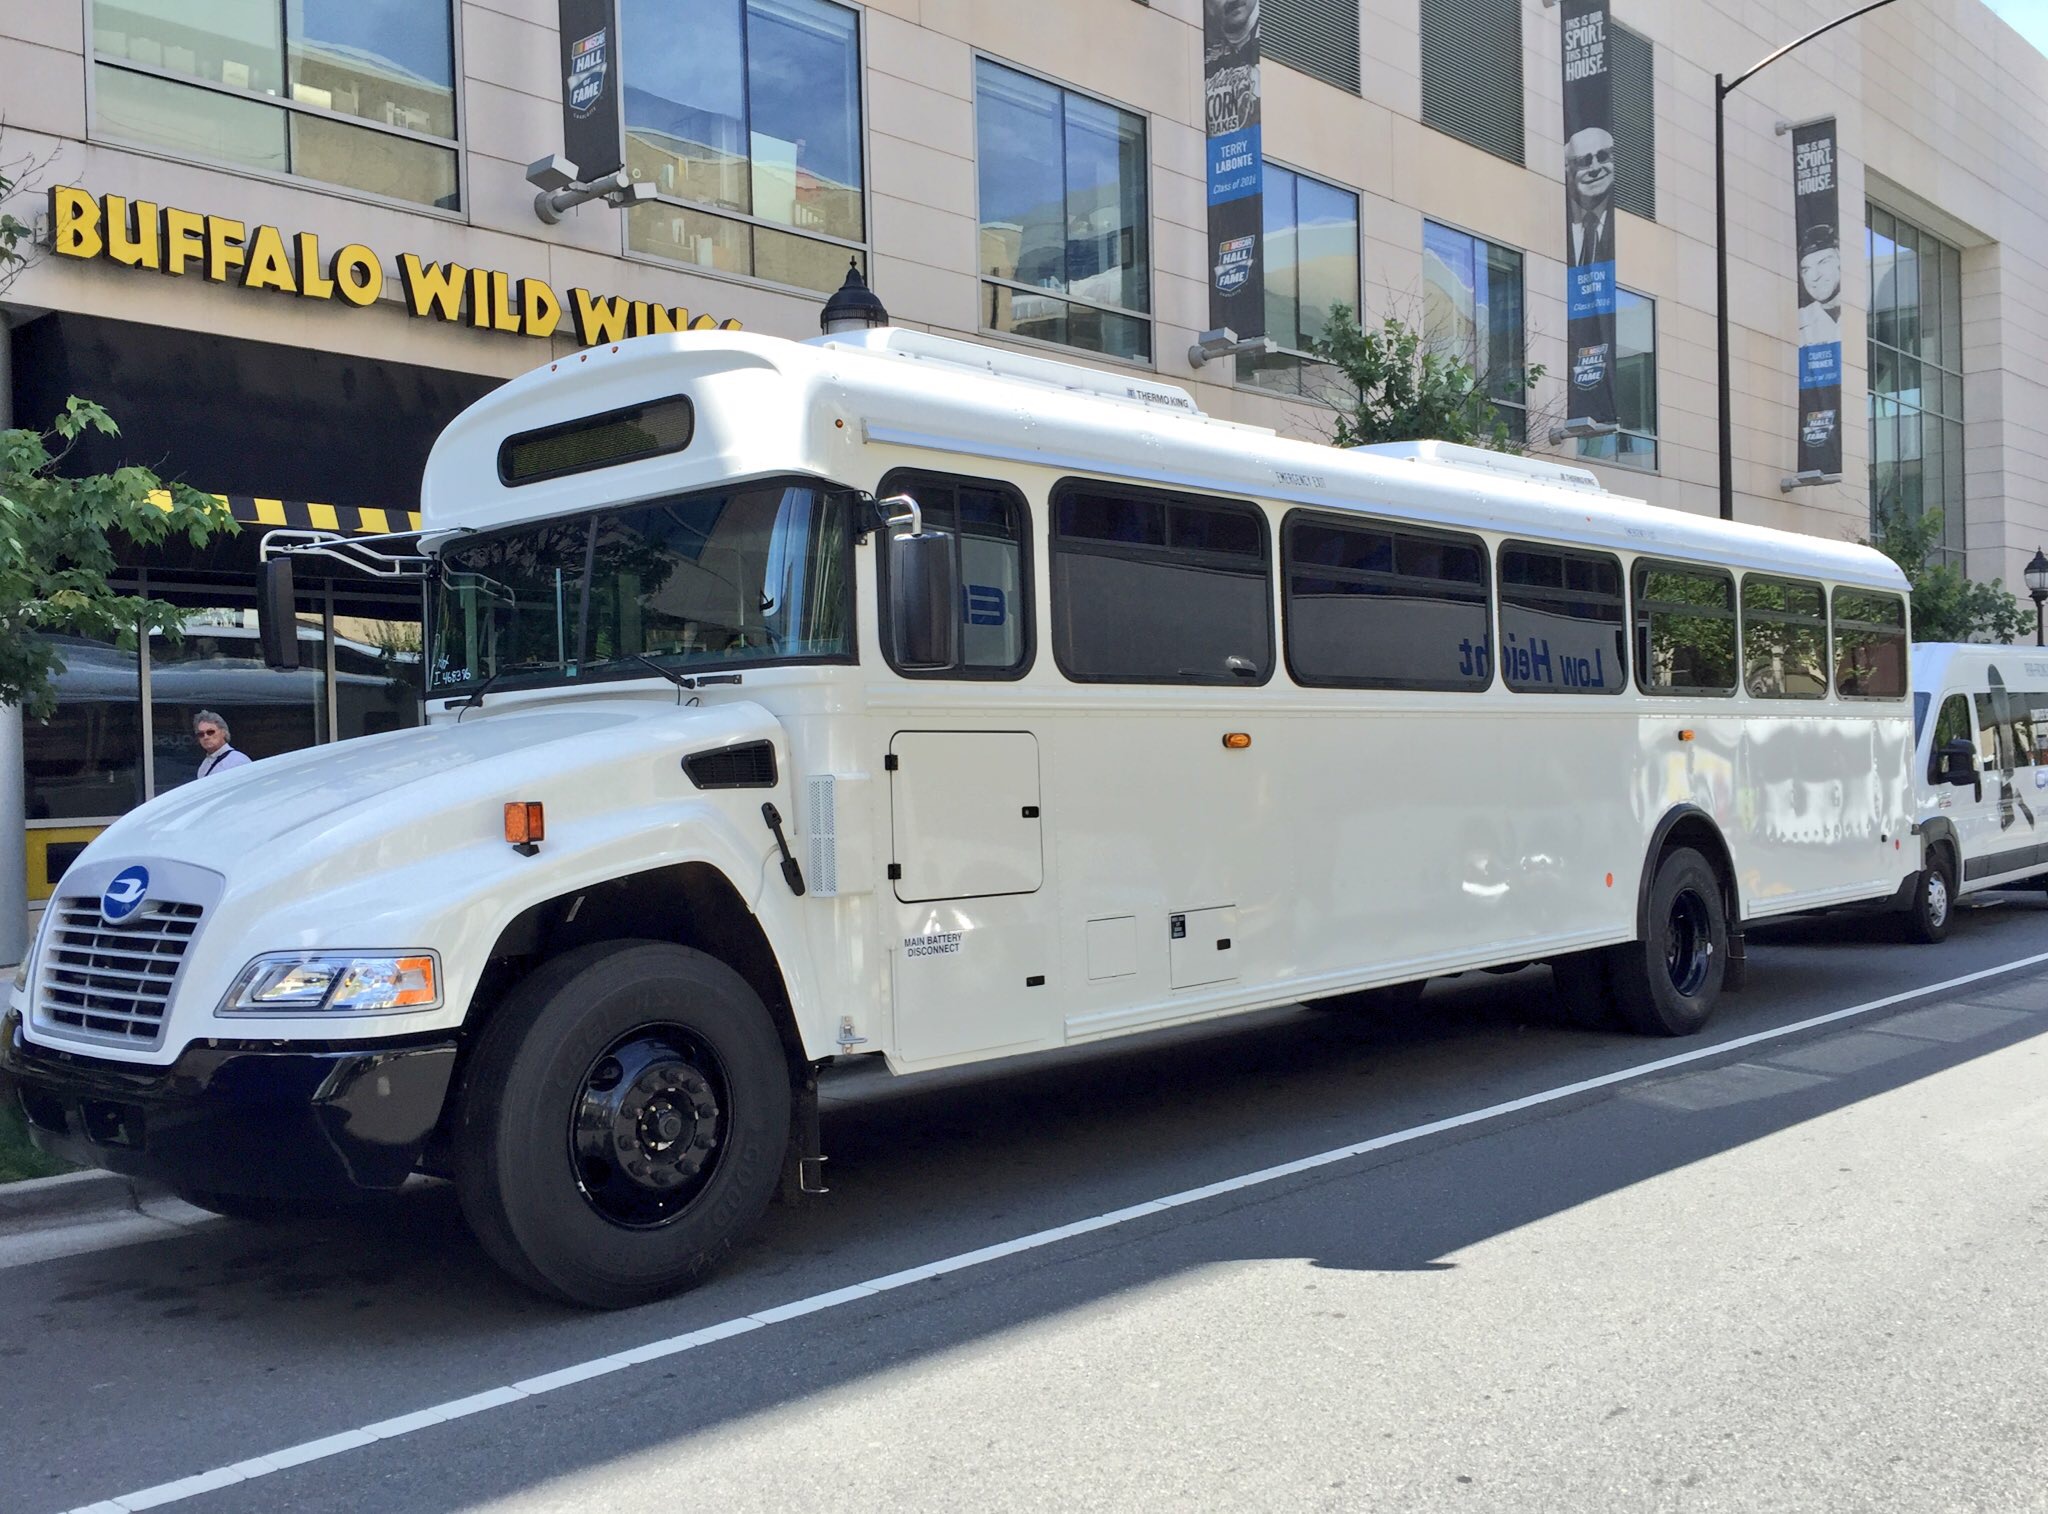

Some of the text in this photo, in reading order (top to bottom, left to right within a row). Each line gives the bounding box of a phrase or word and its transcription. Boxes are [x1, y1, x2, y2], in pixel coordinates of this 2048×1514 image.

[1581, 14, 1589, 26] IS
[1565, 21, 1607, 51] SPORT.
[575, 49, 602, 73] HALL
[1582, 46, 1589, 58] IS
[1565, 53, 1608, 81] HOUSE.
[572, 80, 600, 104] FAME
[1220, 140, 1248, 158] TERRY
[1215, 152, 1254, 174] LABONTE
[1797, 147, 1834, 170] SPORT.
[1798, 173, 1835, 196] HOUSE.
[48, 184, 384, 307] BUFFALO
[396, 252, 562, 338] WILD
[1222, 249, 1249, 265] HALL
[1219, 271, 1246, 287] FAME
[1581, 354, 1604, 366] HALL
[1577, 370, 1602, 383] FAME
[1136, 389, 1189, 408] THERMO KING
[904, 933, 962, 947] MAIN BATTERY
[908, 943, 959, 957] DISCONNECT
